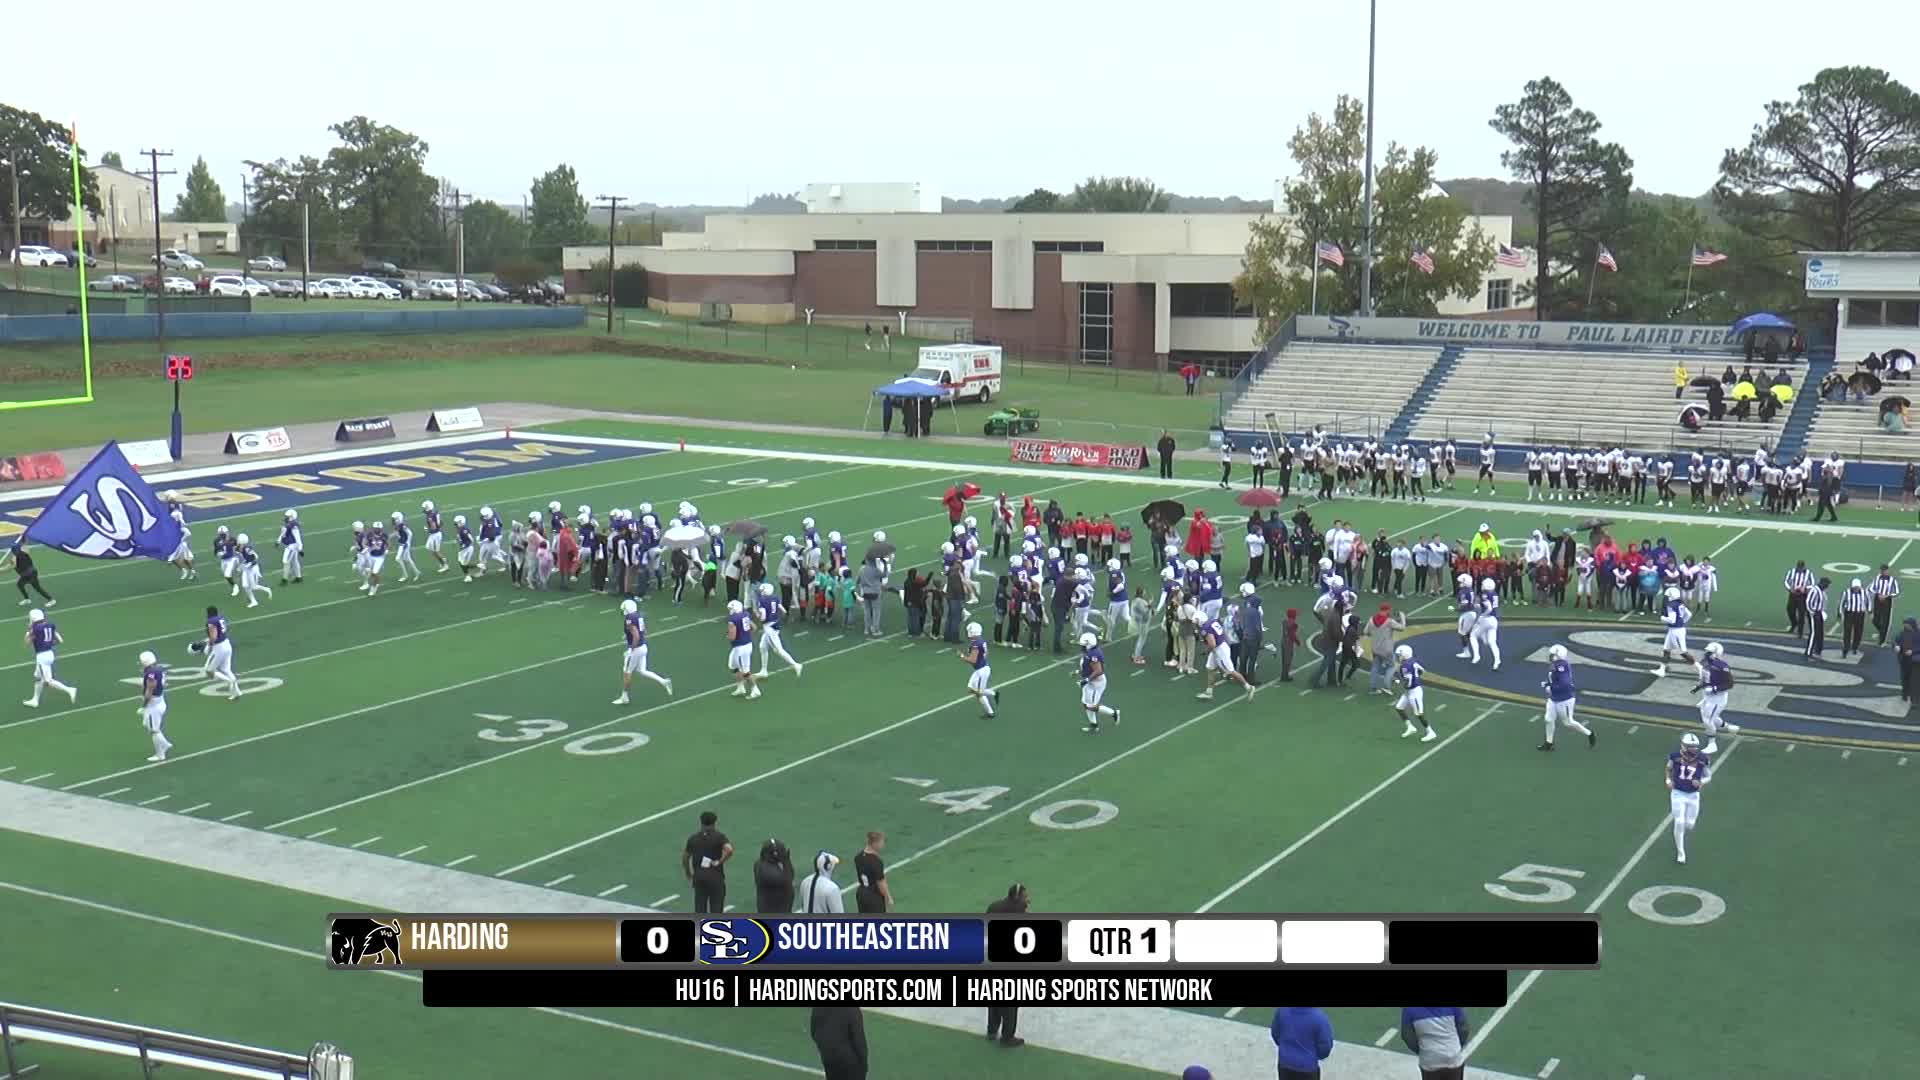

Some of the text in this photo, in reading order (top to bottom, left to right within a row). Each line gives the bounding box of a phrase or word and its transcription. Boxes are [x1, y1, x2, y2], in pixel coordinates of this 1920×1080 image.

[1418, 320, 1511, 340] WELCOME
[1517, 323, 1542, 340] TO
[1566, 325, 1616, 344] PAUL
[1621, 326, 1685, 345] LAIRD
[167, 355, 193, 381] 25
[1017, 441, 1045, 452] RED
[1109, 447, 1140, 458] RED
[1016, 451, 1042, 462] ZONE
[1108, 456, 1138, 467] ZONE
[155, 442, 597, 508] STORM
[1679, 765, 1697, 780] 17
[1483, 863, 1727, 926] 50
